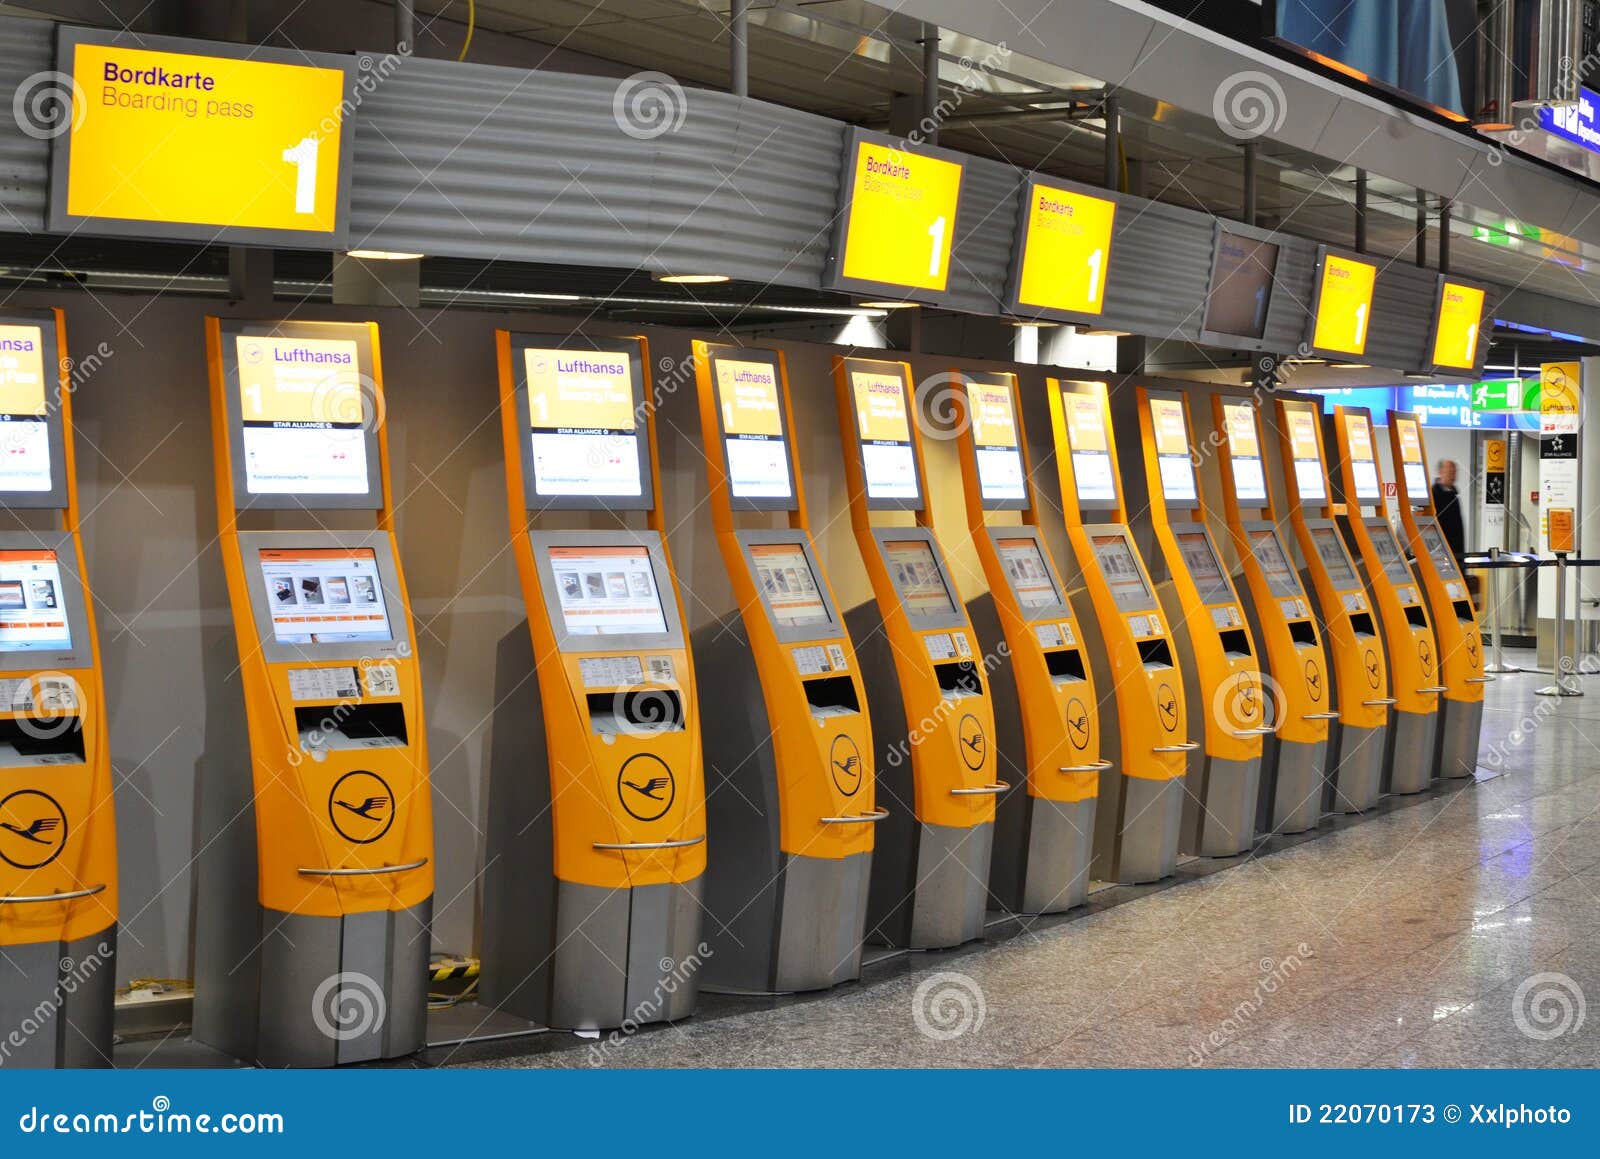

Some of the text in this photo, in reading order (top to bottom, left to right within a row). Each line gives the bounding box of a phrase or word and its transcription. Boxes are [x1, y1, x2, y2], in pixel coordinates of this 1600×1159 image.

[103, 62, 215, 91] Bordkarte
[102, 86, 254, 119] Boarding pass
[282, 137, 318, 214] 1
[866, 155, 911, 180] Bordkarte
[928, 216, 946, 276] 1
[1087, 249, 1102, 302] 1
[1354, 304, 1366, 345] 1
[274, 347, 351, 365] Lufthansa
[1466, 323, 1476, 361] 1
[557, 358, 625, 375] Lufthansa
[734, 369, 772, 385] Lufthansa
